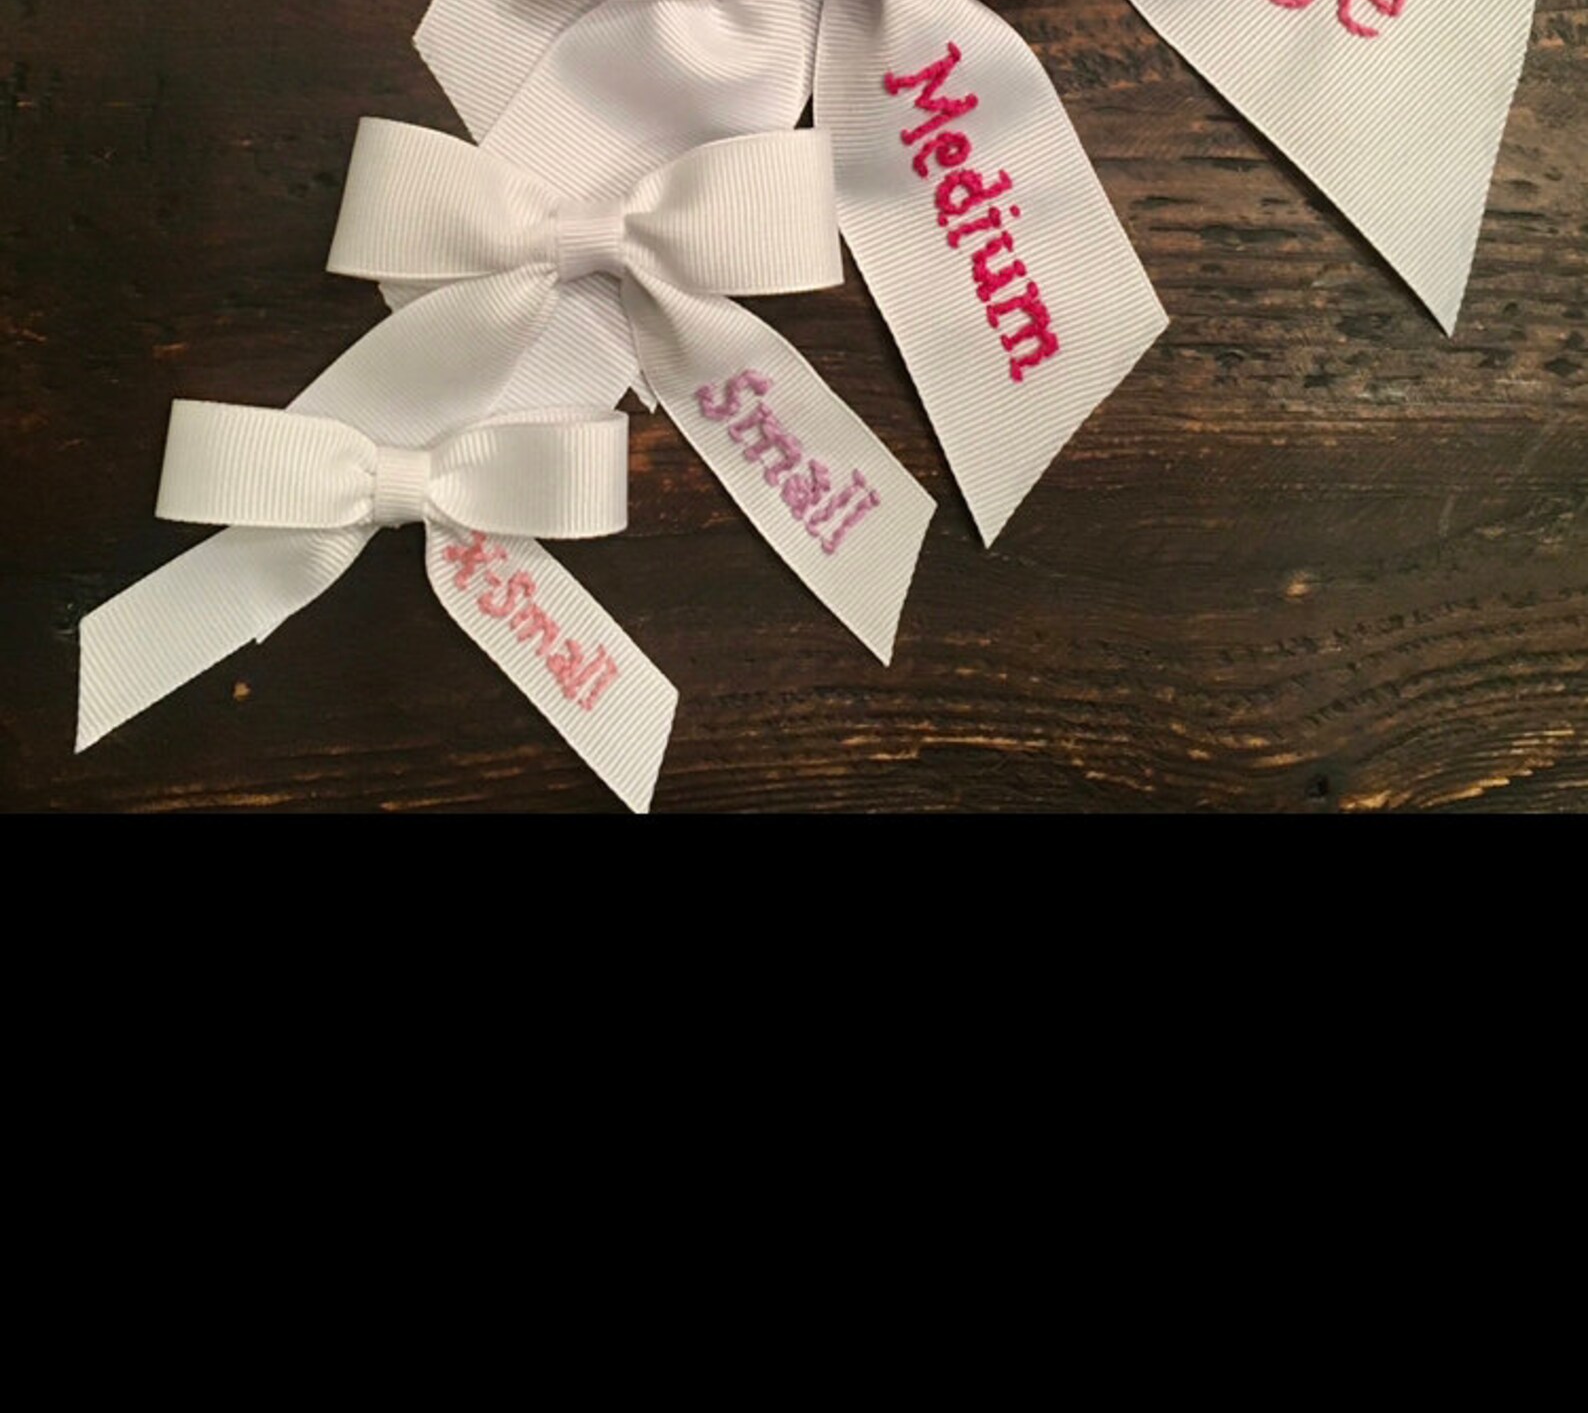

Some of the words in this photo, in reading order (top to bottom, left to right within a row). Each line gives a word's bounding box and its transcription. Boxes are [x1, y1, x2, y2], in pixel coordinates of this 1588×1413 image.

[882, 40, 1061, 384] Medium
[694, 368, 881, 555] Small
[442, 530, 619, 711] X-Small
